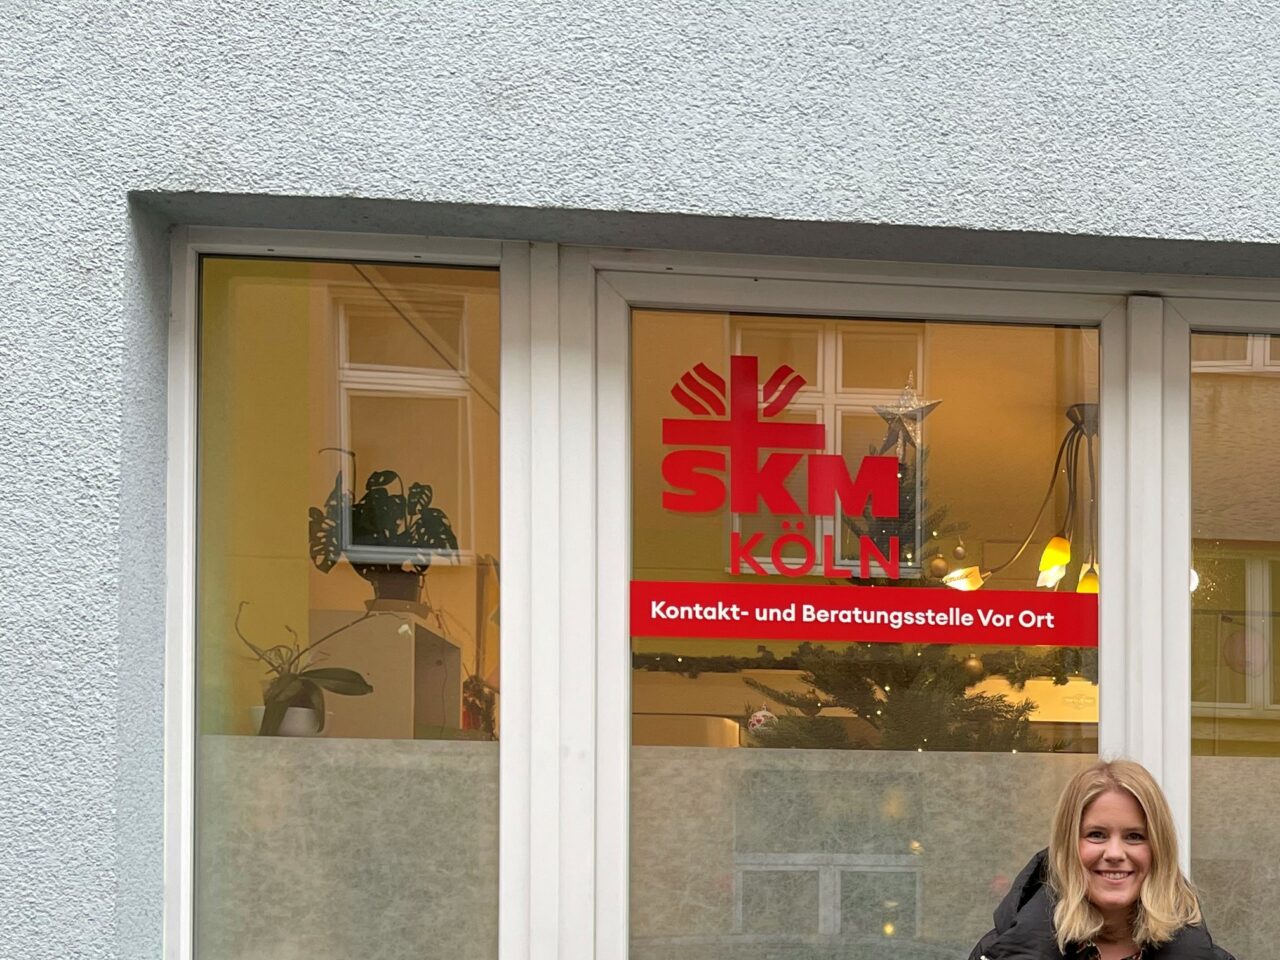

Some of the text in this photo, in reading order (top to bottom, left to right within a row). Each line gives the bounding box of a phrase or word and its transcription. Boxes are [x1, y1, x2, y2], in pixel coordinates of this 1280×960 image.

[661, 449, 899, 518] SKM
[730, 521, 900, 580] KÖLN
[650, 600, 1056, 629] Kontakt- und Beratungsstelle Vor Ort
